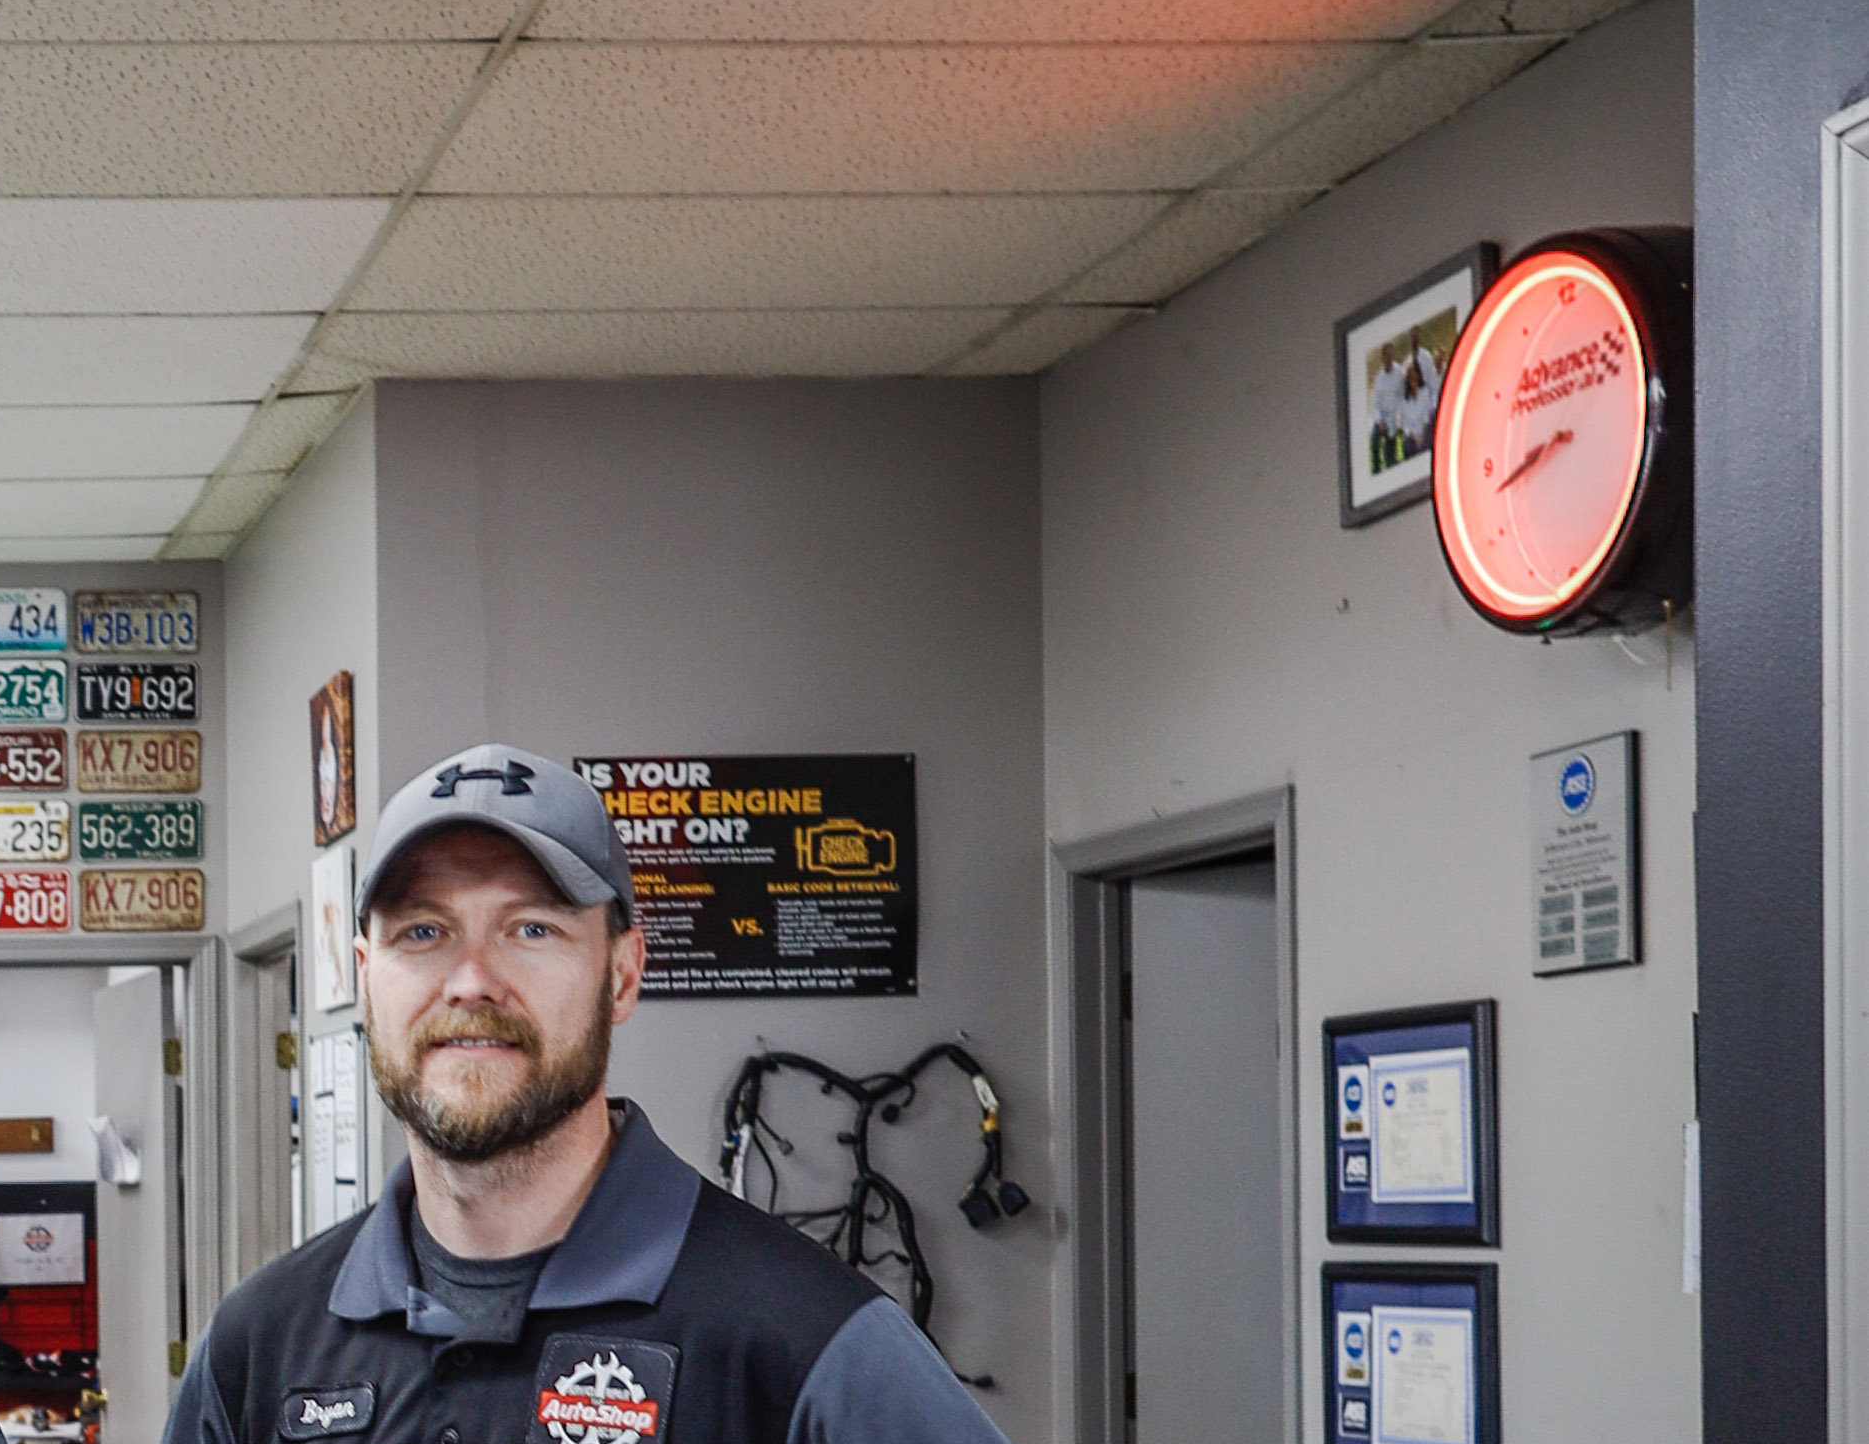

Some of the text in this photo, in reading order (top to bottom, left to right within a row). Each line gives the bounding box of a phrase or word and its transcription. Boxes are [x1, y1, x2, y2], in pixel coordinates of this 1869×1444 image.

[1483, 457, 1494, 478] 9
[618, 761, 712, 788] YOUR
[603, 788, 823, 816] HECK ENGINE
[615, 818, 751, 845] GHT ON?
[820, 835, 866, 850] CHECK
[819, 849, 869, 864] ENGINE
[766, 882, 800, 894] BASIC
[802, 881, 834, 893] CODE
[731, 918, 764, 936] VS.
[671, 969, 688, 978] and
[704, 969, 719, 978] are
[775, 968, 810, 977] cleared
[812, 967, 839, 977] codes
[841, 967, 858, 976] will
[859, 967, 892, 976] remain
[641, 979, 671, 989] leared
[672, 979, 689, 989] and
[692, 980, 712, 990] your
[714, 978, 741, 988] check
[743, 979, 774, 990] engine
[776, 977, 799, 989] light
[800, 977, 817, 987] will
[299, 1399, 356, 1429] Bryan
[540, 1398, 654, 1432] AutoShop
